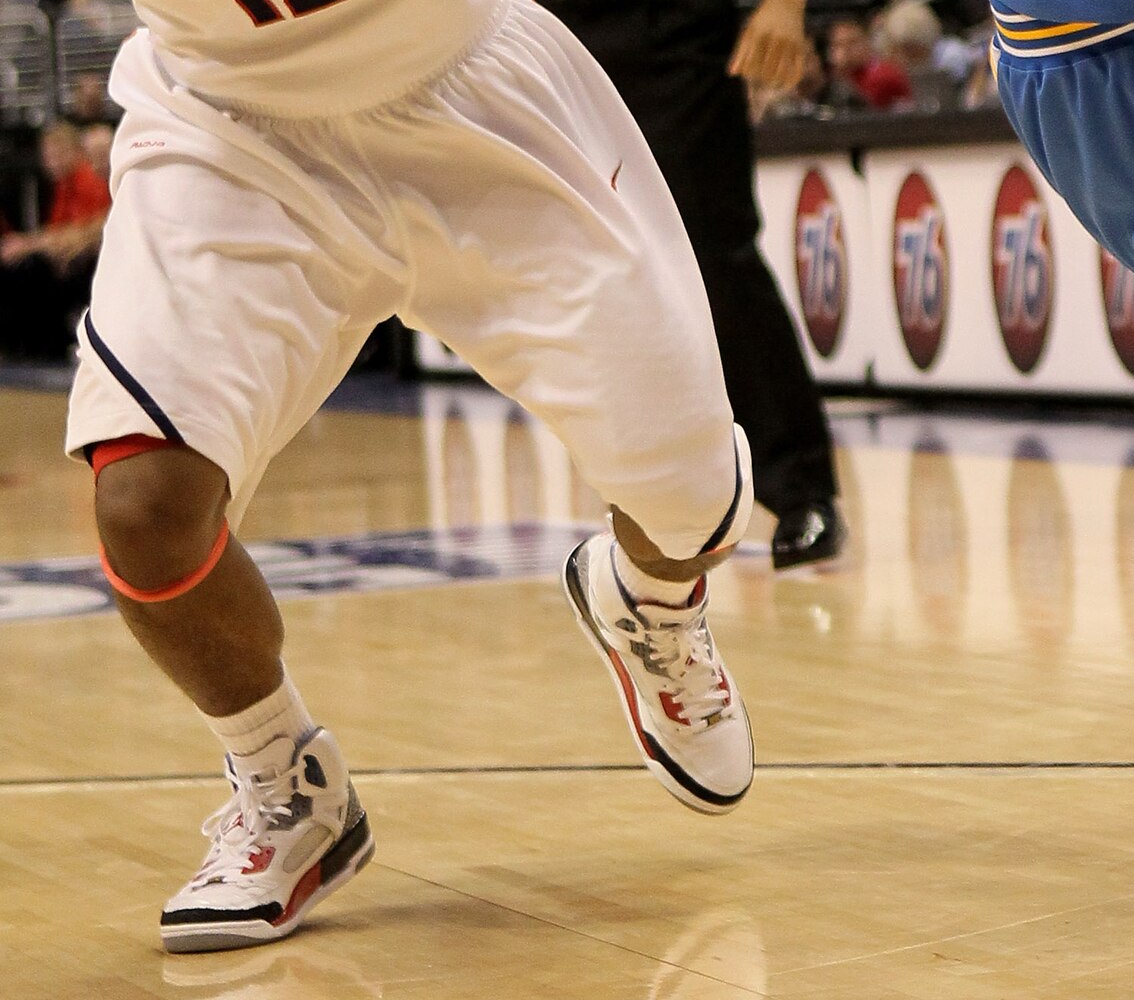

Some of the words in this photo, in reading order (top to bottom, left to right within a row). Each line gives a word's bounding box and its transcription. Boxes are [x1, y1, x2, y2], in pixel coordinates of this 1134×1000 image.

[800, 204, 846, 319] 76
[896, 206, 949, 328] 76
[995, 203, 1051, 330] 76
